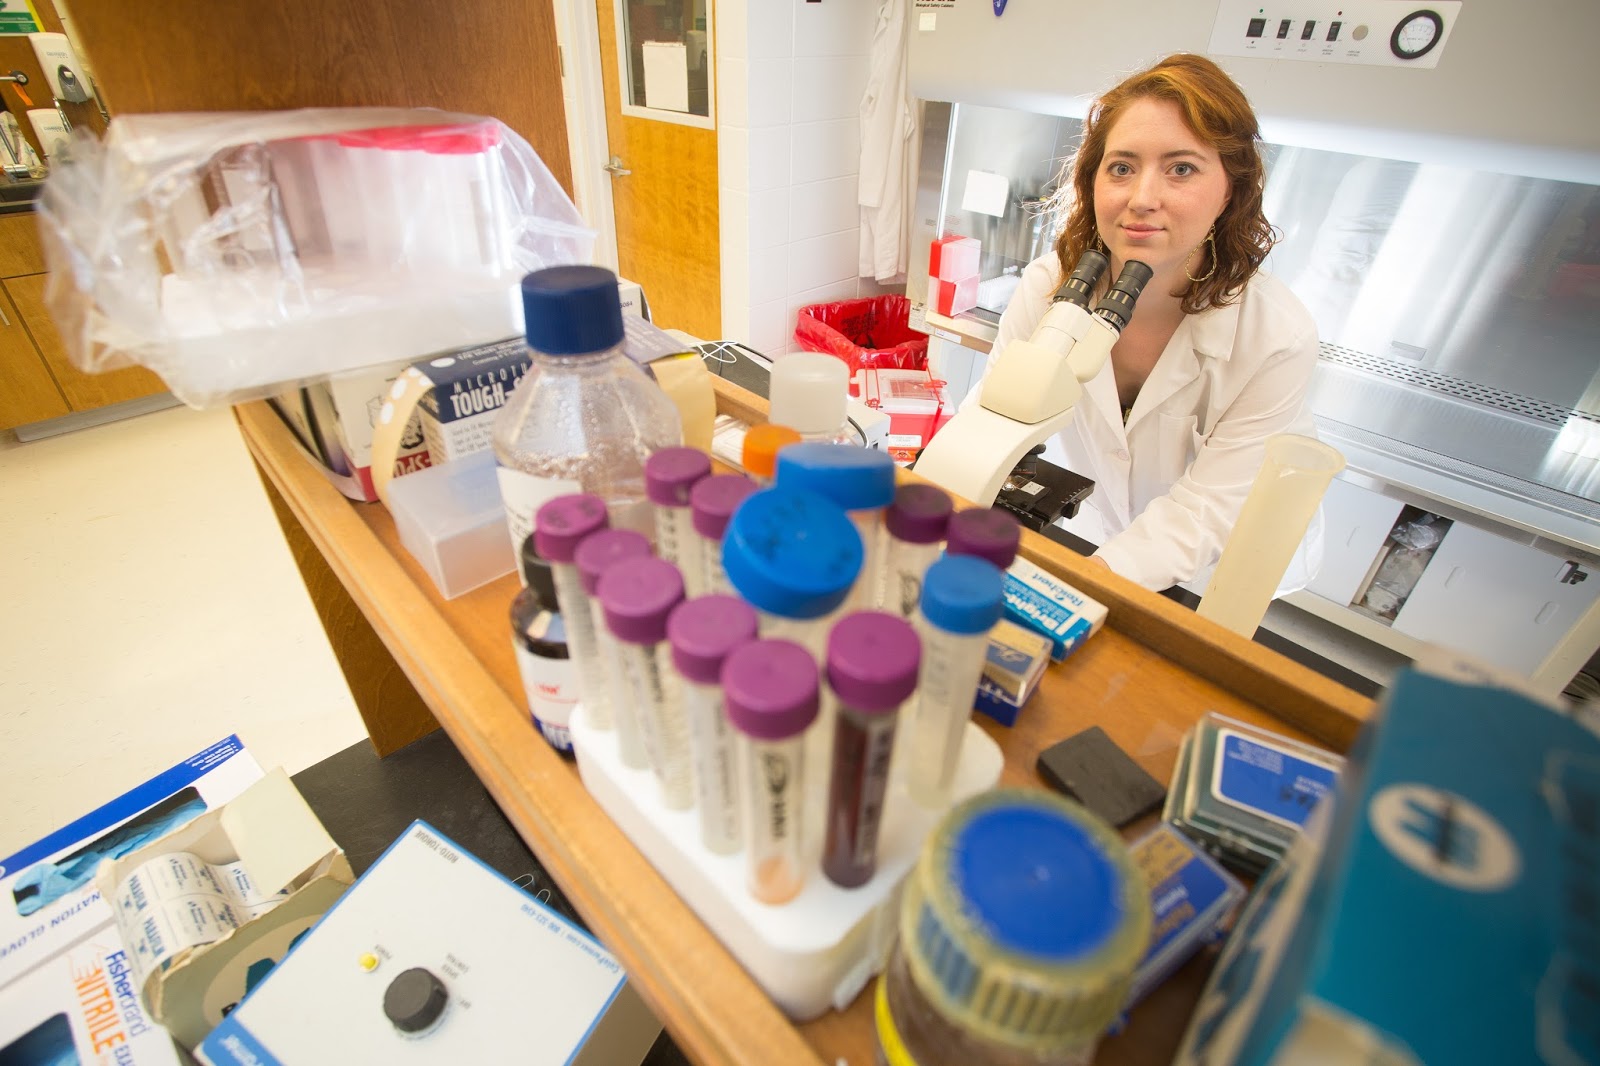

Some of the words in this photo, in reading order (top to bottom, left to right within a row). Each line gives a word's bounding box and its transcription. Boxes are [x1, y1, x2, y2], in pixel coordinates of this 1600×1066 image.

[1032, 573, 1084, 607] Reichert
[414, 828, 460, 865] ROTO-TORQUE
[75, 969, 125, 1054] NITRILE
[105, 950, 151, 1037] Fisherbrand
